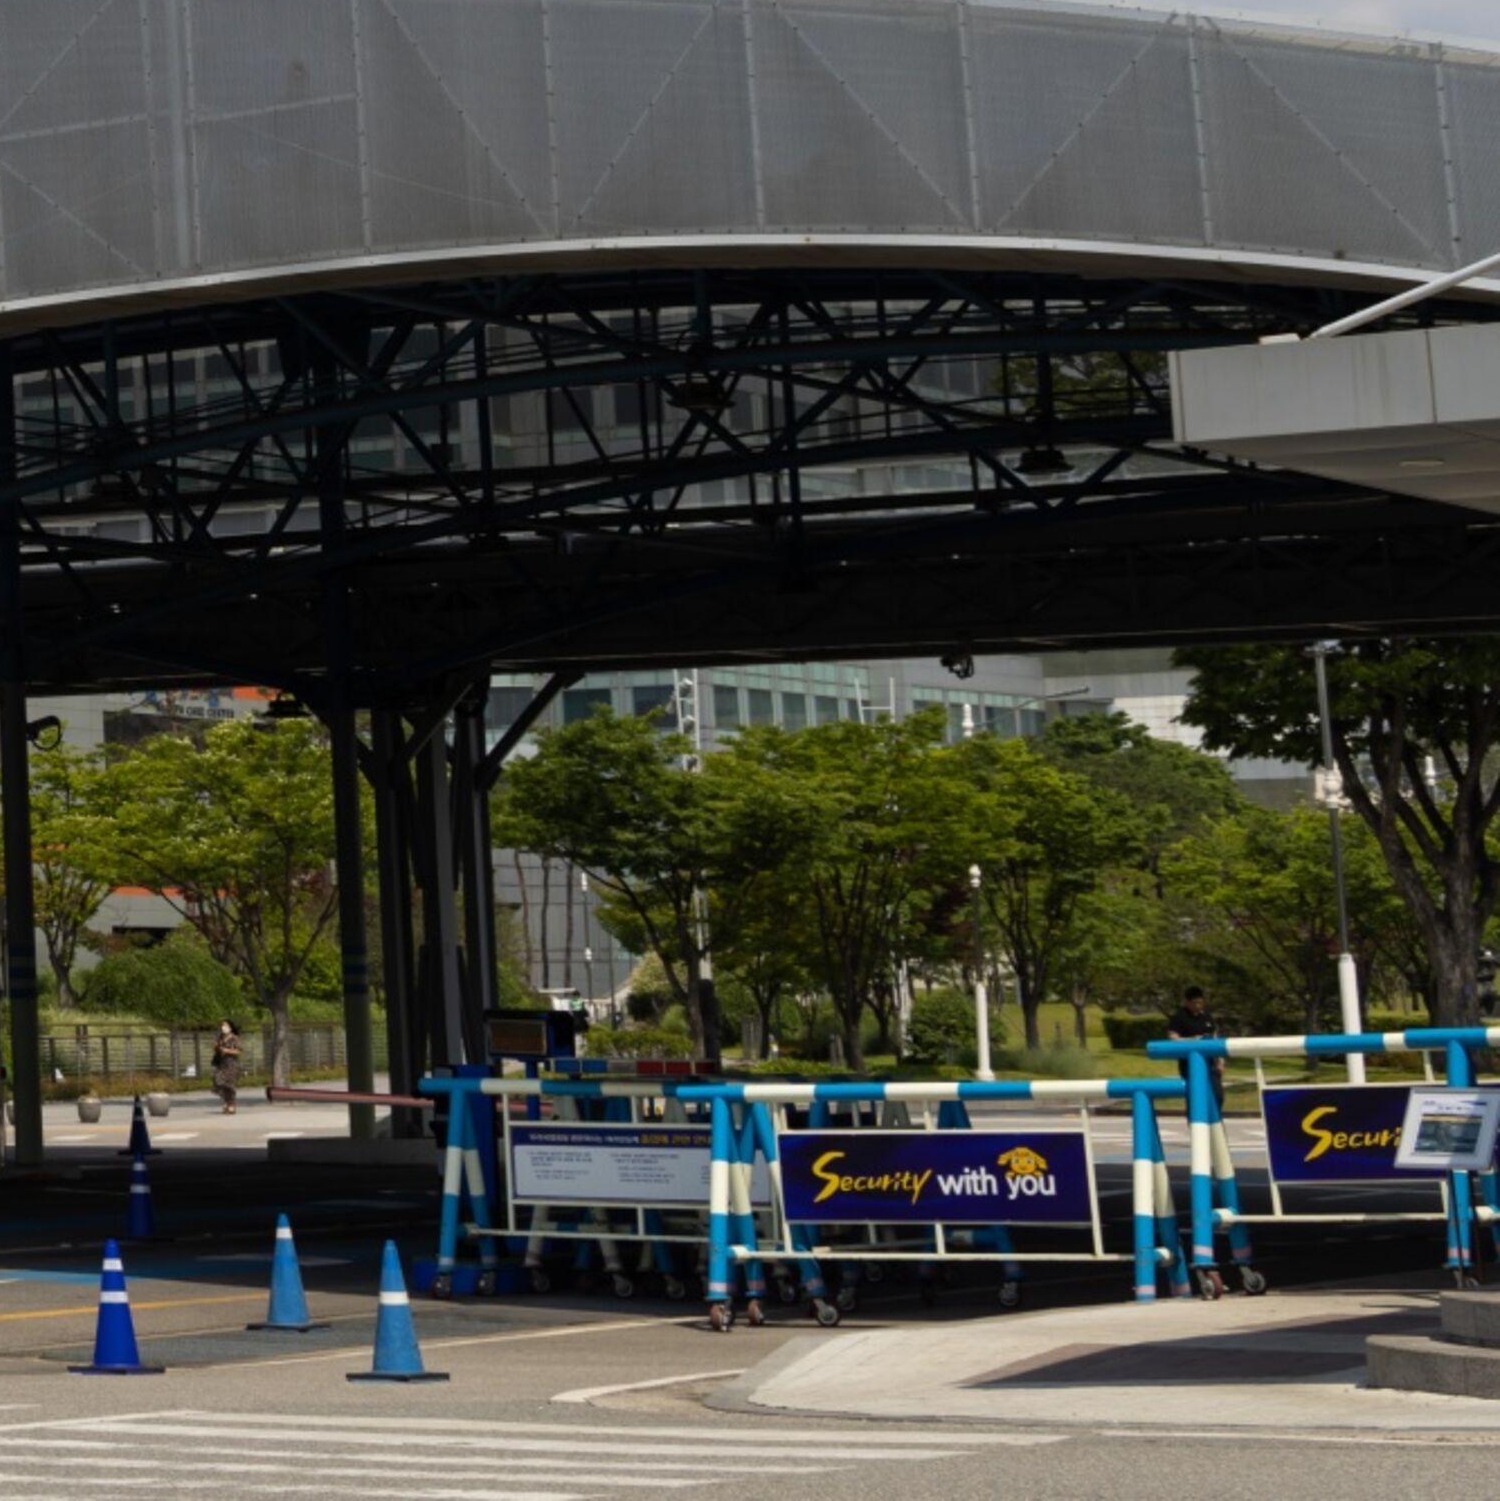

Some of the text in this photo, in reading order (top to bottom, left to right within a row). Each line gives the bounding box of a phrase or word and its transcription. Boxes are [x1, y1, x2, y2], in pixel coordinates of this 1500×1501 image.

[1302, 1107, 1401, 1162] Securi
[811, 1151, 1056, 1205] Security with you
